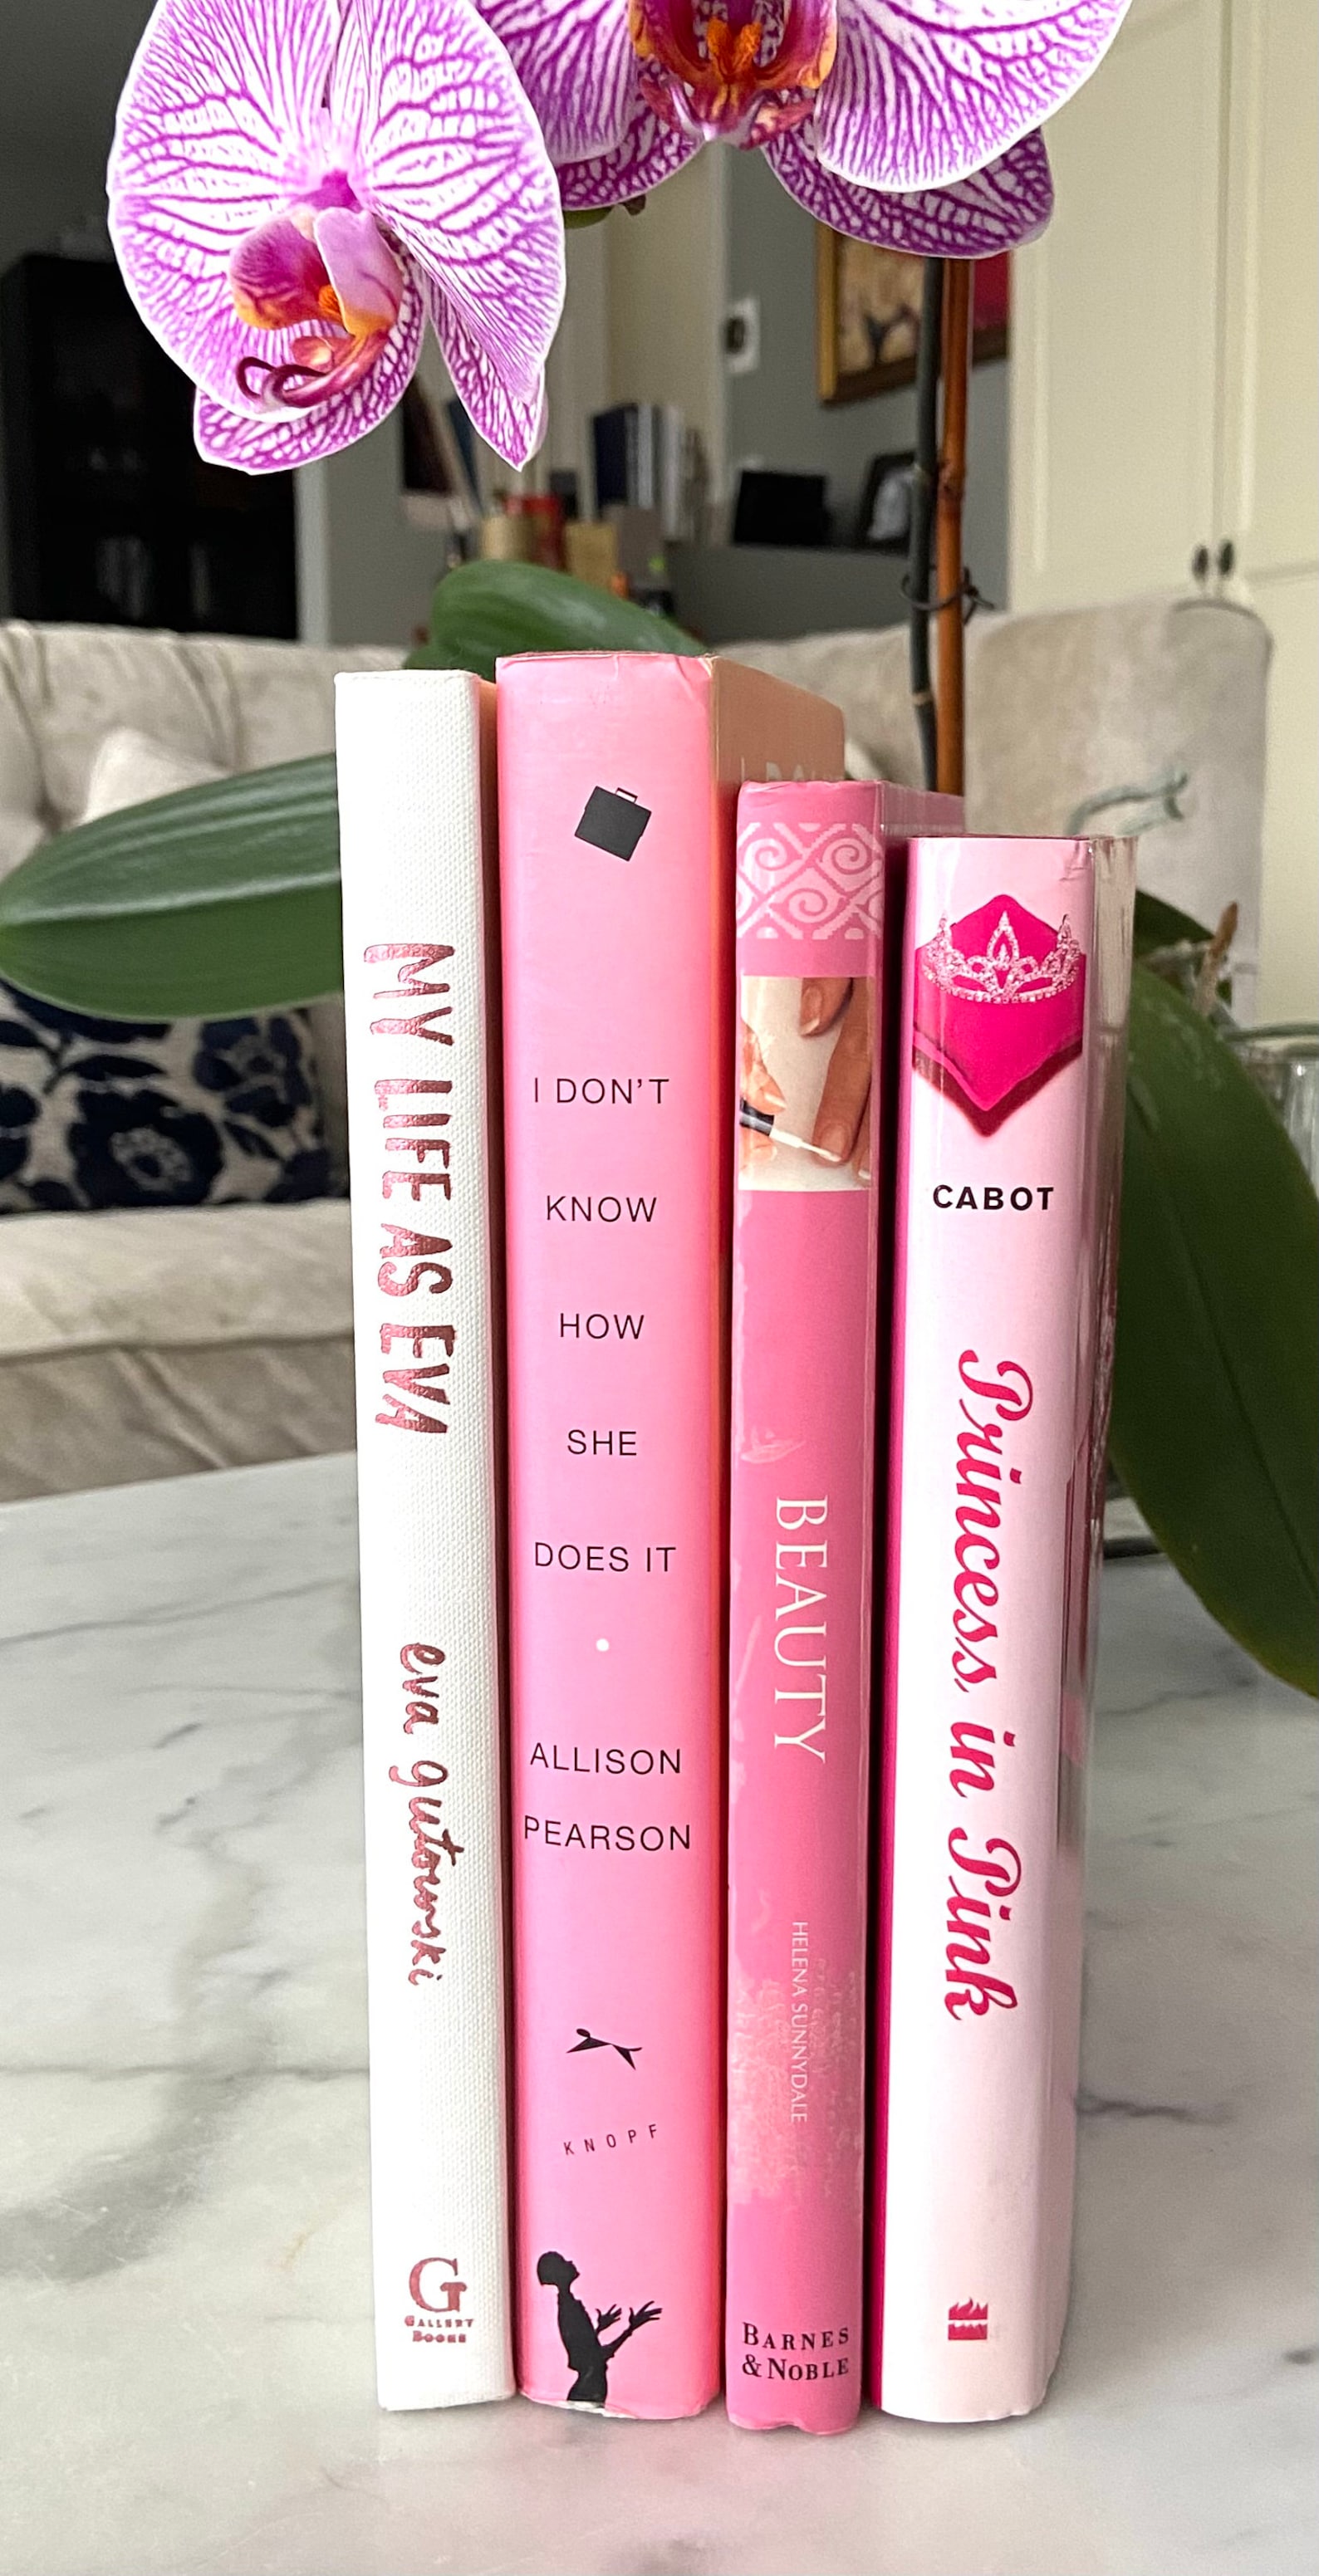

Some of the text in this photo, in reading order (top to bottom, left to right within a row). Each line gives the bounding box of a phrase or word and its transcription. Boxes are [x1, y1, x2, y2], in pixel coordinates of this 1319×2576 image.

[556, 1077, 669, 1104] DON'T
[363, 943, 457, 1434] MY LIFE AS EVA
[932, 1183, 1055, 1212] CABOT
[546, 1194, 658, 1223] KNOW
[559, 1312, 645, 1340] HOW
[566, 1428, 638, 1457] SHE
[534, 1541, 677, 1574] DOES IT
[773, 1494, 829, 1765] BEAUTY
[399, 1642, 446, 1736] eva
[944, 1349, 1034, 2021] Princess in Pink
[529, 1741, 682, 1775] ALLISON
[523, 1814, 691, 1852] PEARSON
[790, 1921, 809, 2123] HELENA SUNNYDALE
[563, 2123, 658, 2156] KNOPF
[409, 2256, 468, 2313] G
[742, 2321, 850, 2351] BARNES
